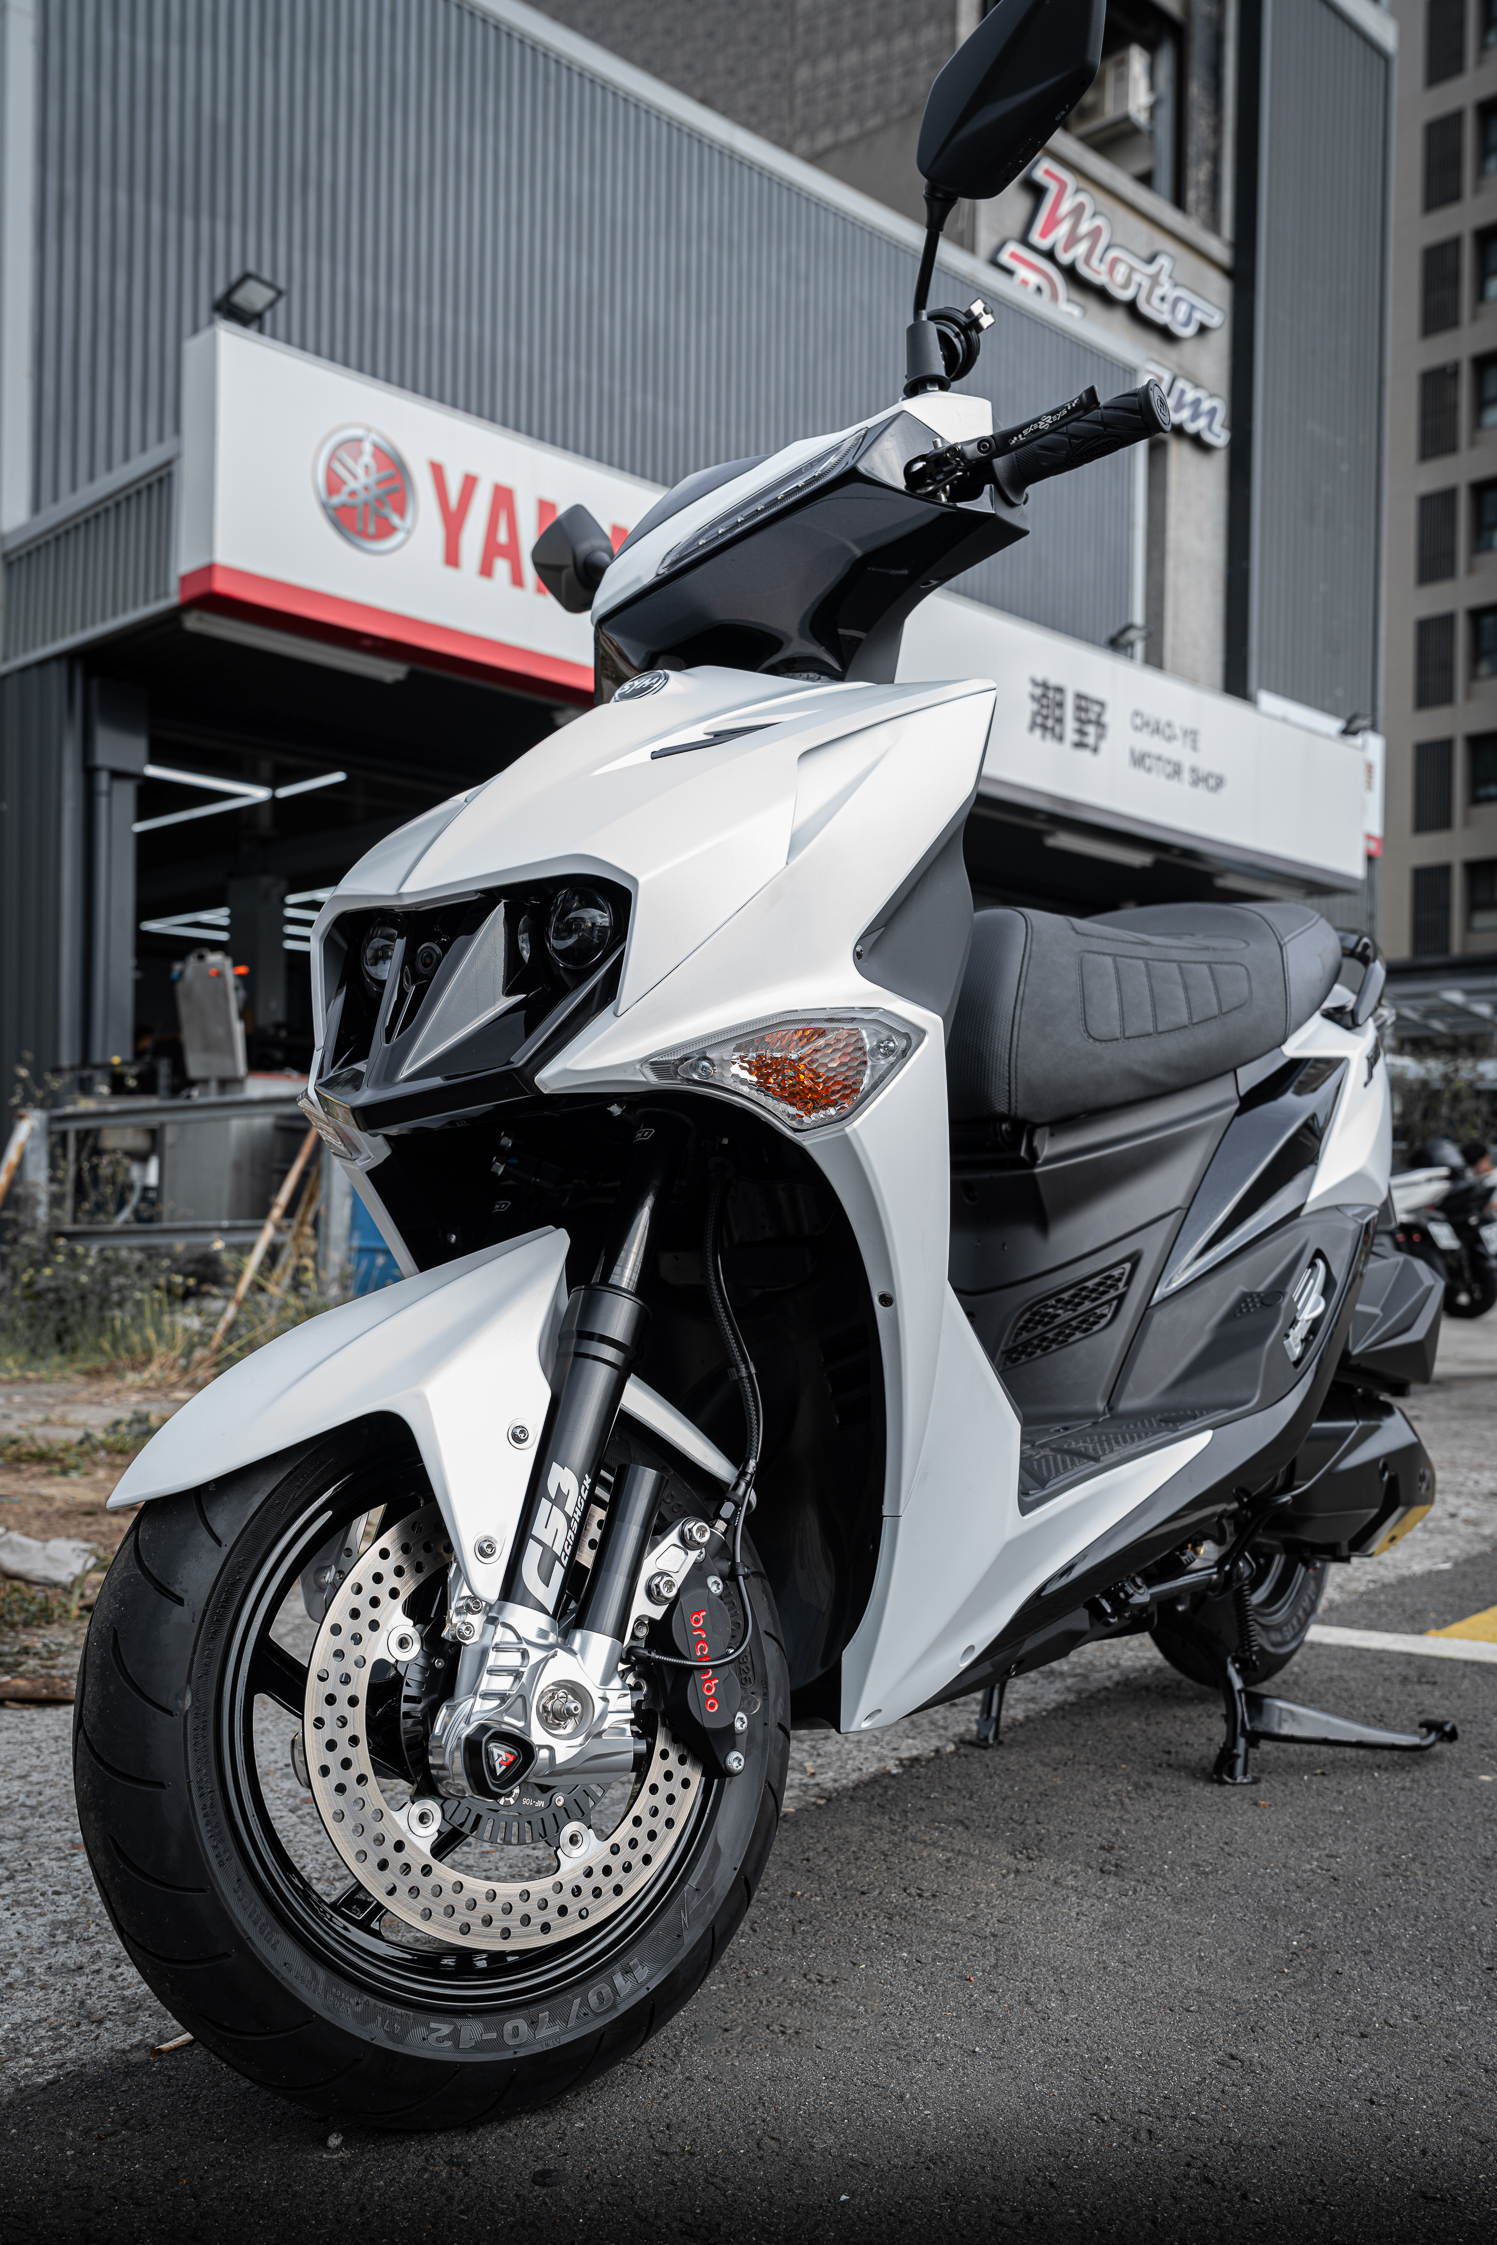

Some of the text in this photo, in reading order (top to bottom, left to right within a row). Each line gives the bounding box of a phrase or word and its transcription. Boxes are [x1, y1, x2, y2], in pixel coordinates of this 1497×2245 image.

[1028, 675, 1108, 755] 潮野
[1129, 746, 1226, 795] MOTOR SHOP
[690, 1609, 719, 1713] brembo
[428, 1955, 652, 2050] 110/70-12
